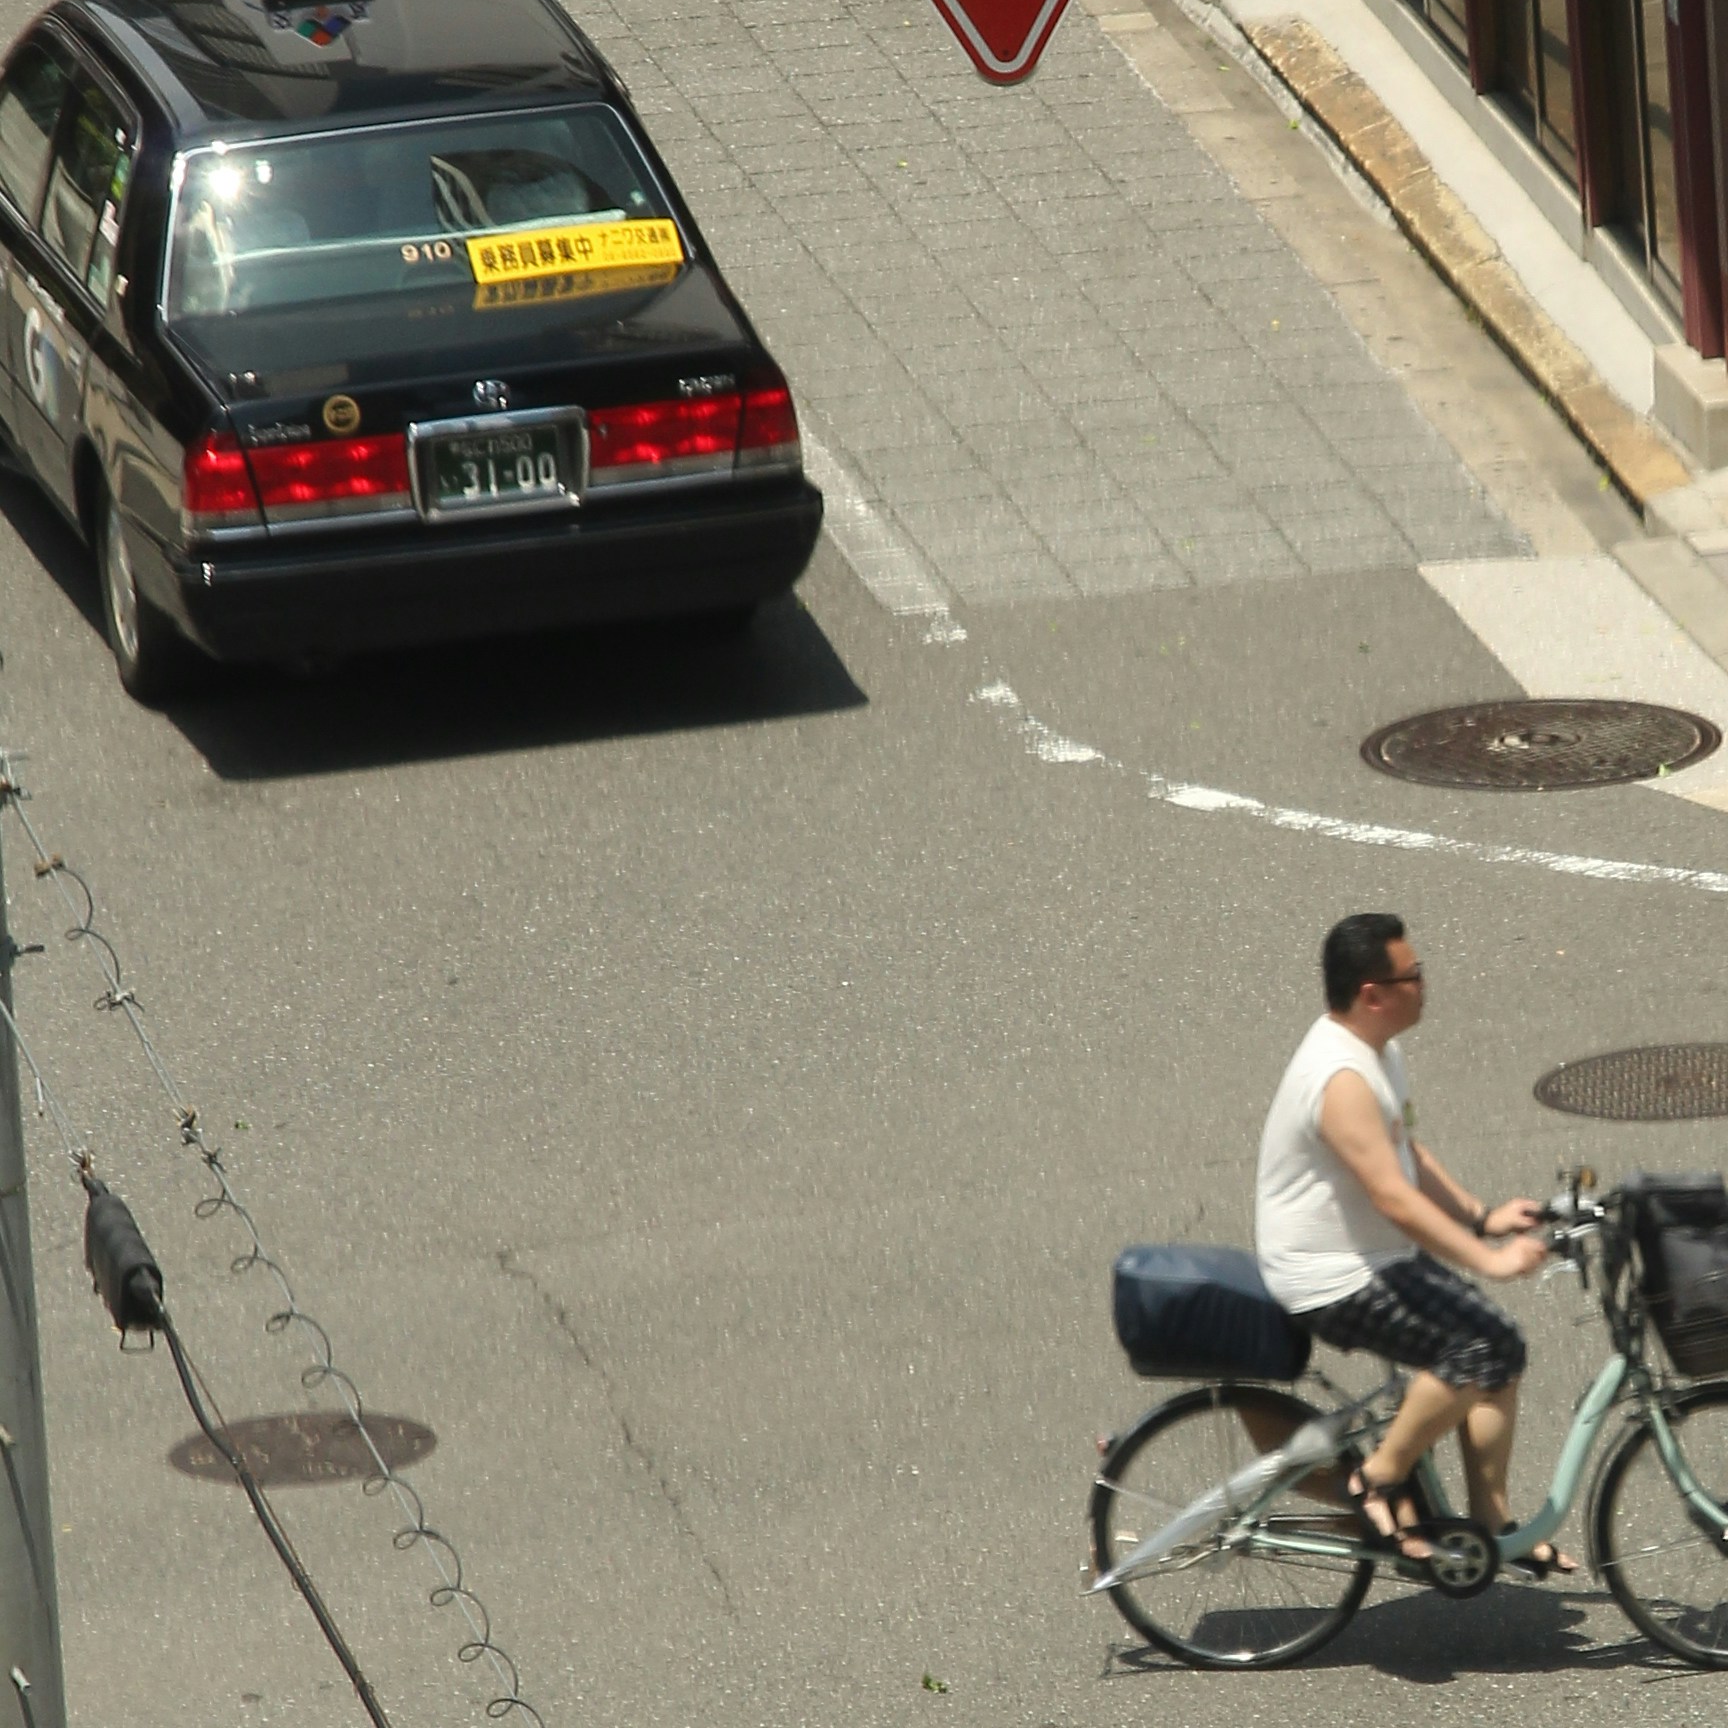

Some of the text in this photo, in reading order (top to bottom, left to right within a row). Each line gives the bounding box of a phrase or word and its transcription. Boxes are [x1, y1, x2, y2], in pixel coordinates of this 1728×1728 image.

[401, 241, 452, 263] 910
[480, 234, 594, 273] 乗務員募集中
[460, 452, 557, 499] 31-00
